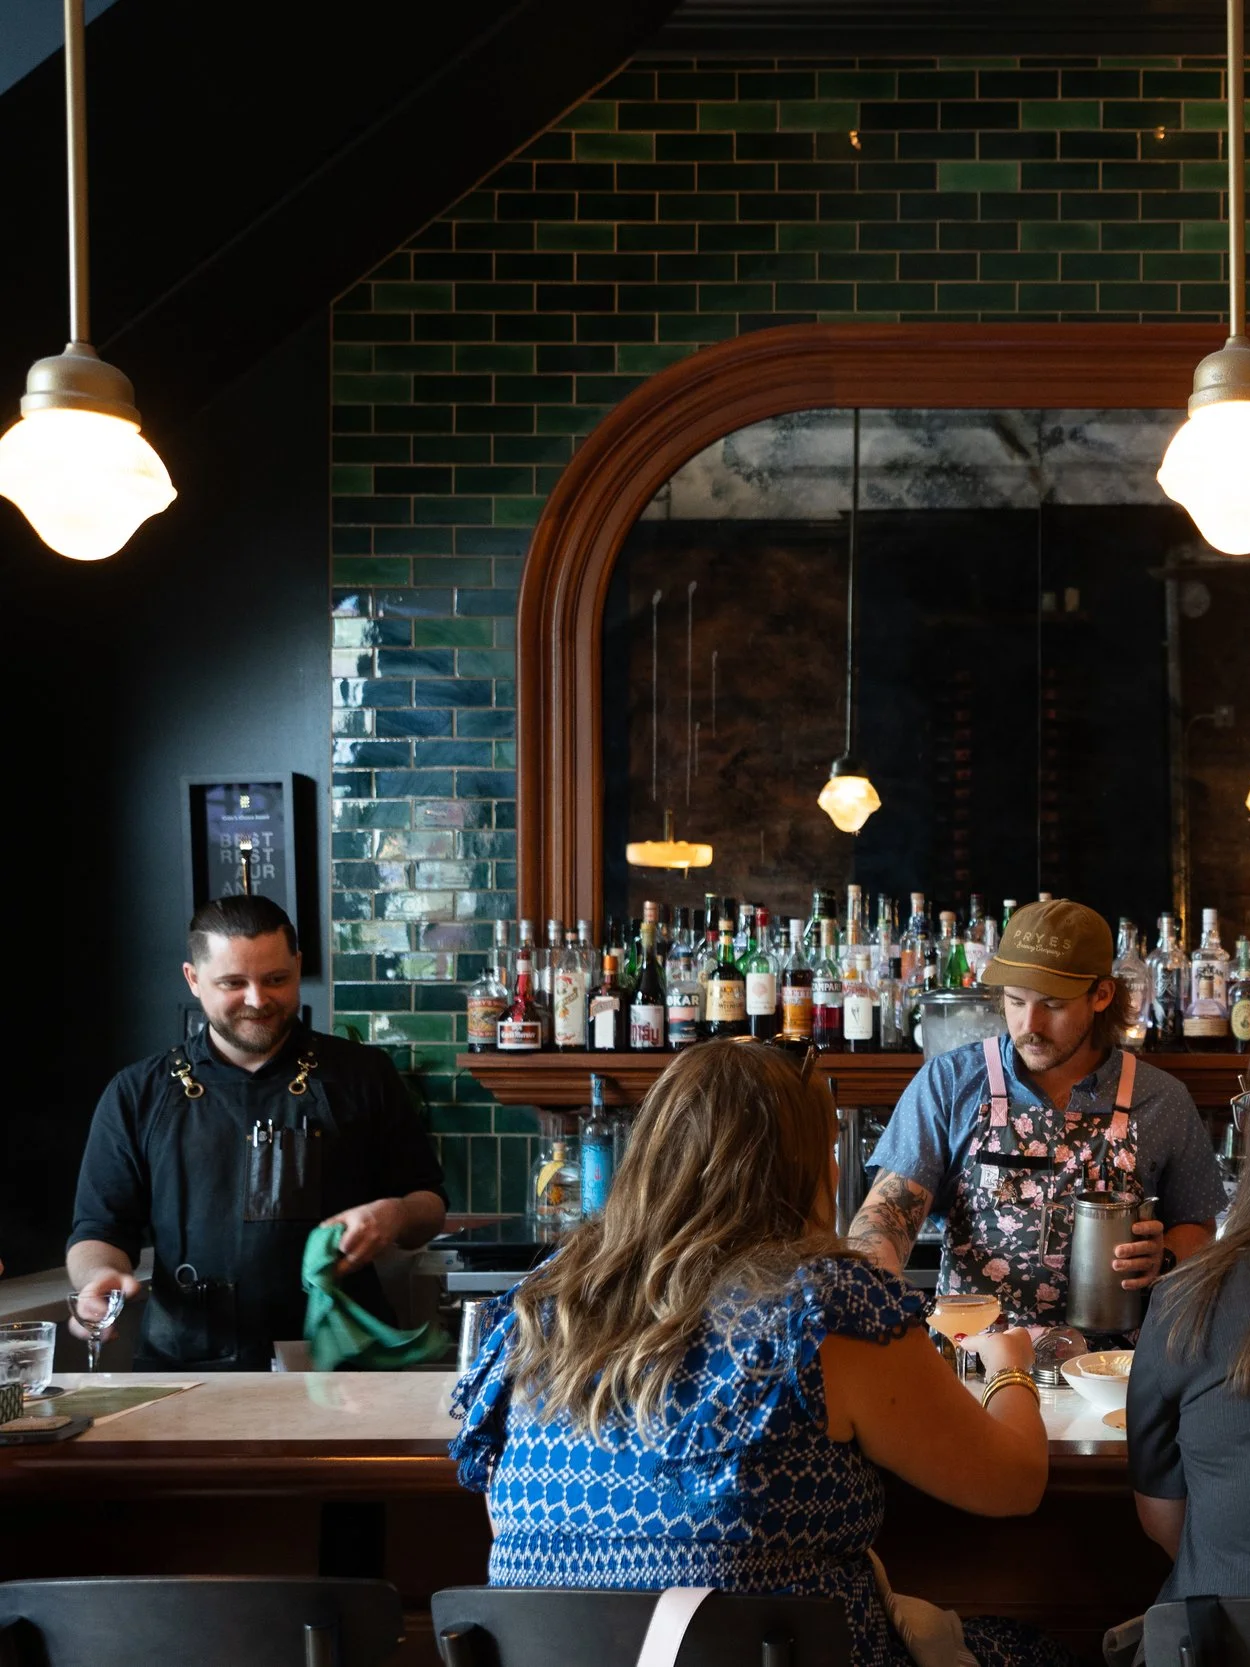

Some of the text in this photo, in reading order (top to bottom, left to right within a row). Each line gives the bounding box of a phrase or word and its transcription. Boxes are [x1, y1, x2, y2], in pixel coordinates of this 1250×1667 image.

[220, 832, 274, 848] BEST
[220, 848, 274, 864] REST
[235, 864, 275, 879] AUR
[1013, 930, 1072, 950] PRYES
[811, 982, 841, 992] CAMPARI
